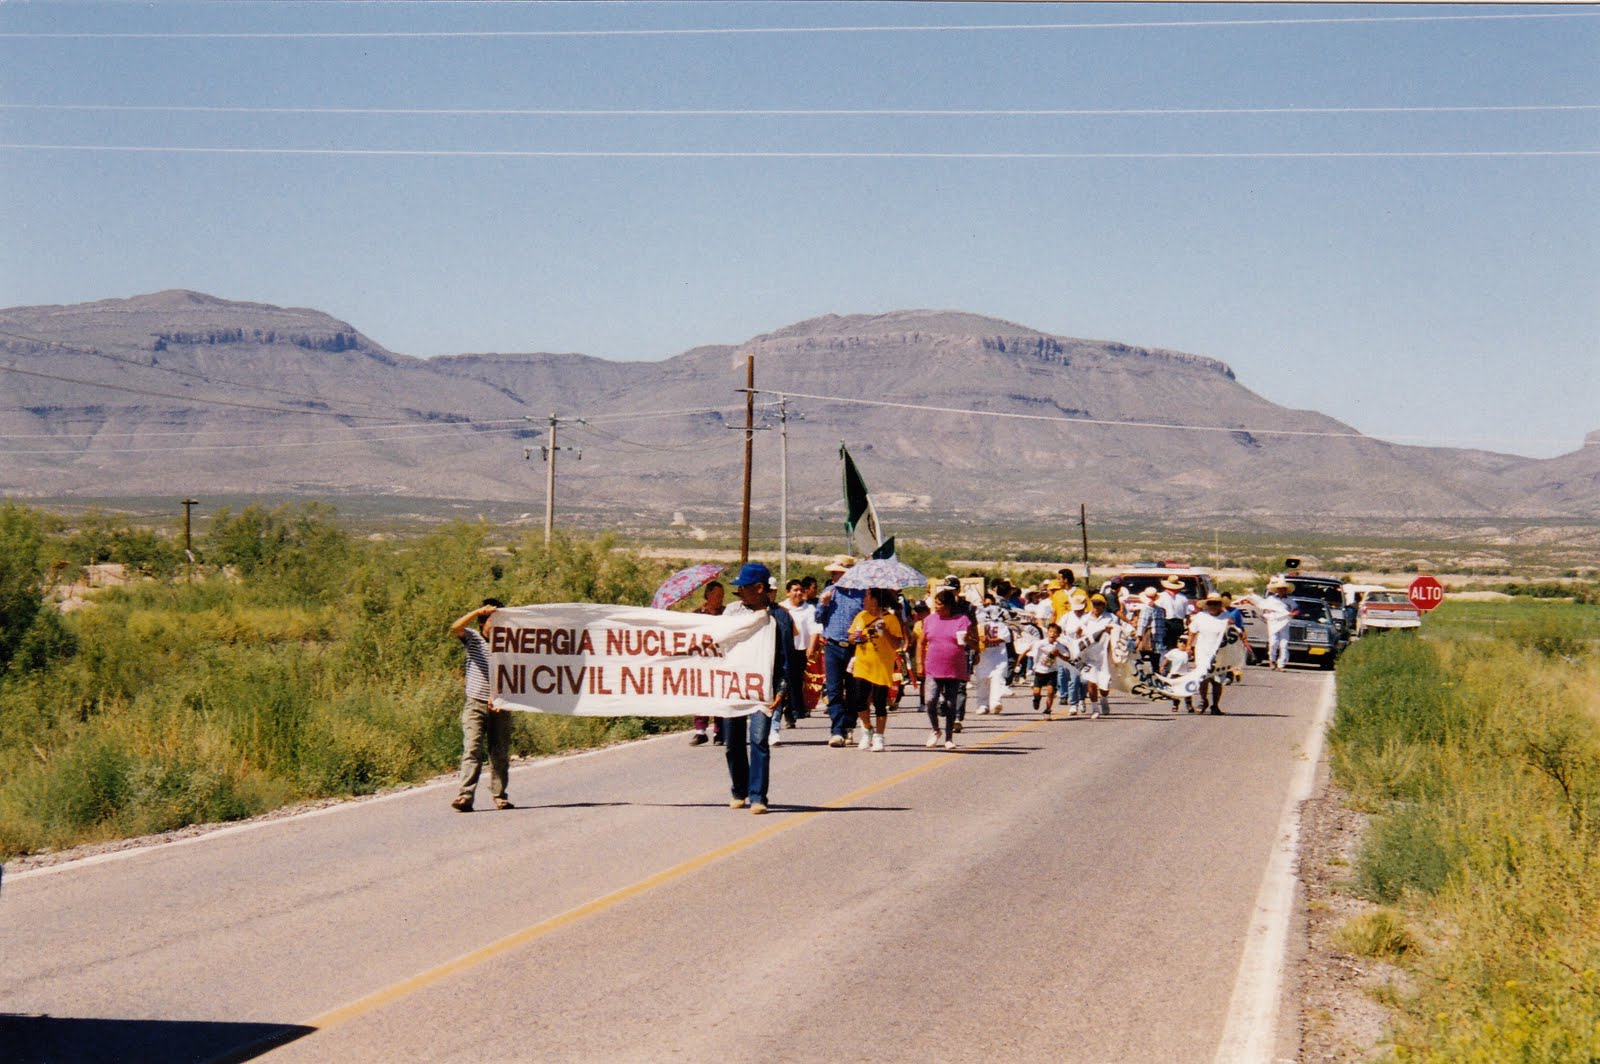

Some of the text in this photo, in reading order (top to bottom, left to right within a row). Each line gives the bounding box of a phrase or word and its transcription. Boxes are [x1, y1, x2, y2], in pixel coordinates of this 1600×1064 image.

[1411, 586, 1441, 600] ALTO
[492, 626, 595, 655] ENERGIA
[497, 665, 765, 702] NI CIVIL NI MILITAR
